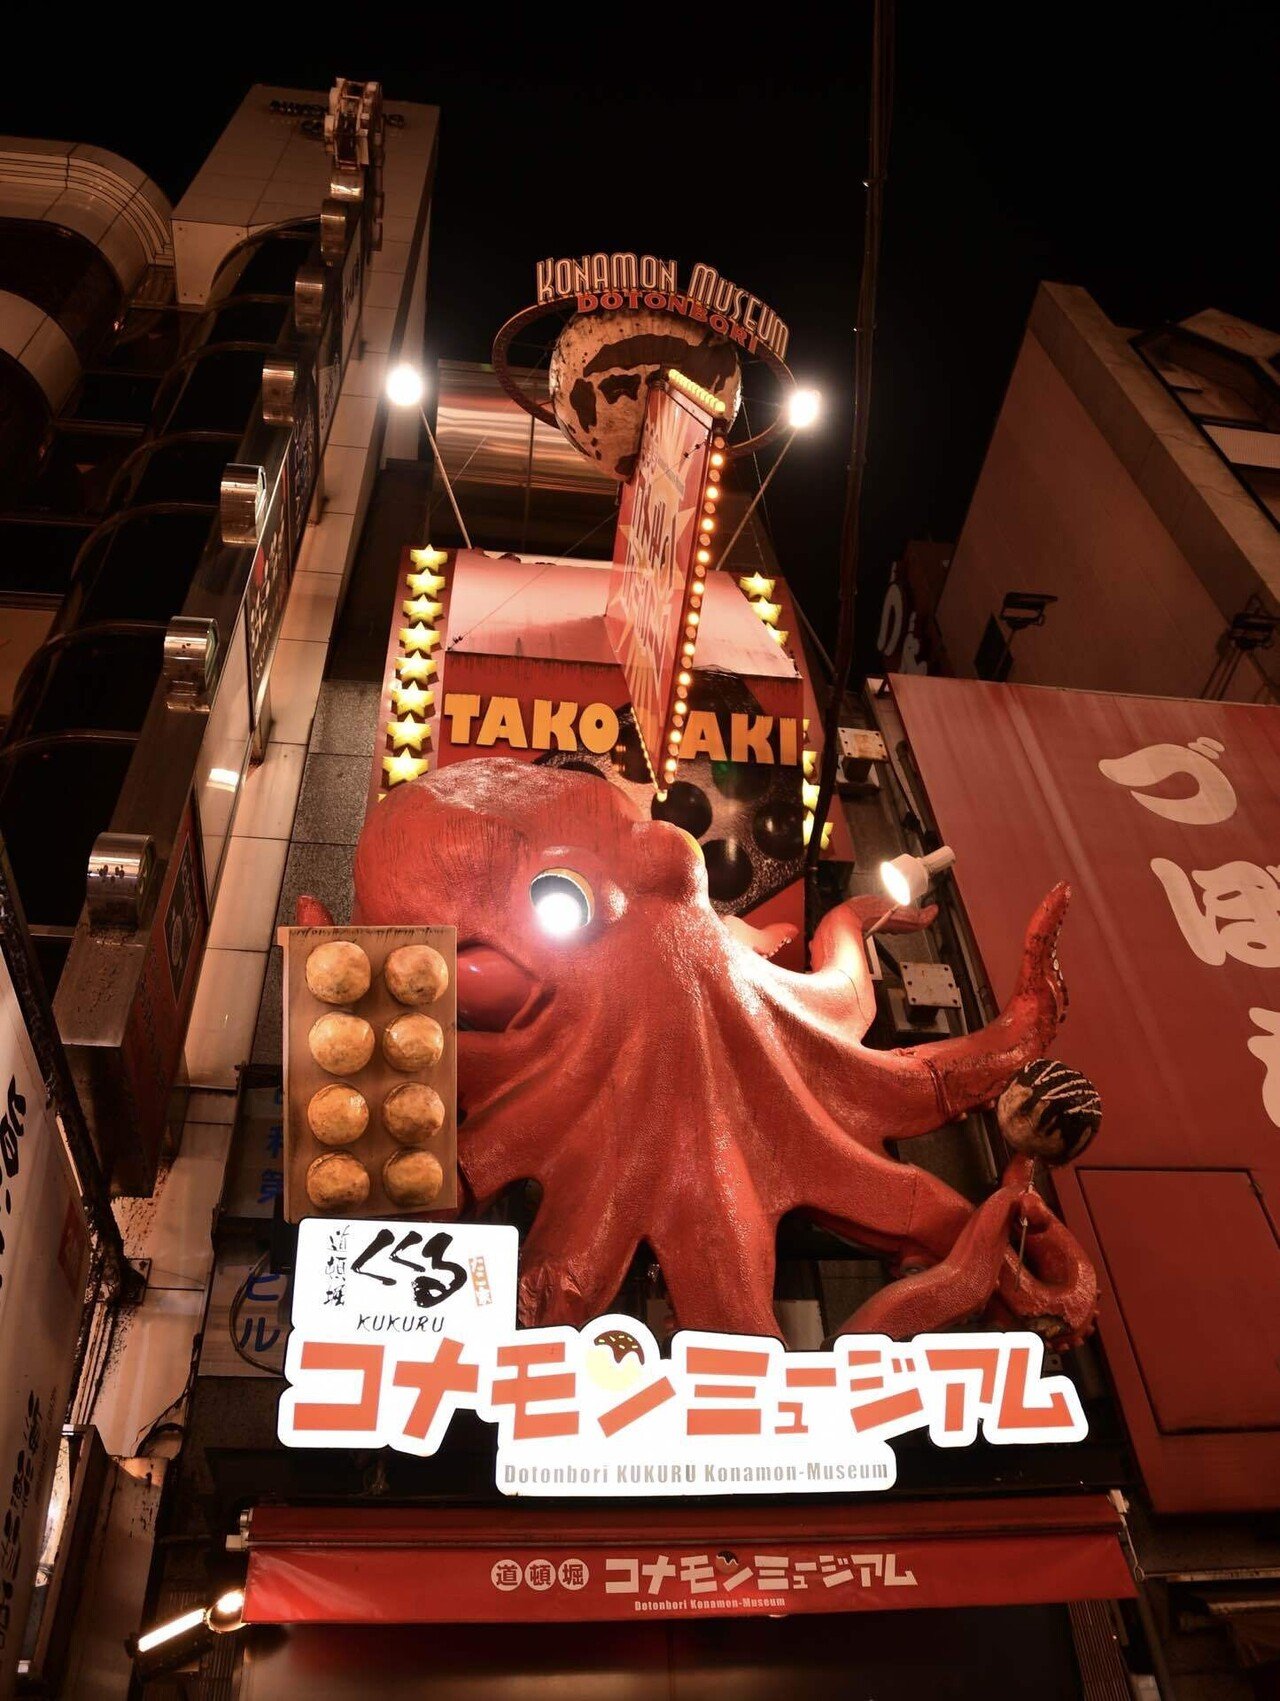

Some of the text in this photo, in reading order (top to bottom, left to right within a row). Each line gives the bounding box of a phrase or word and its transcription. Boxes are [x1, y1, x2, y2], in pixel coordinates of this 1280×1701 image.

[536, 252, 790, 360] KONAMON MUSEUM
[577, 291, 757, 354] DOTONBORI
[444, 693, 798, 766] TAKOAKI
[323, 1224, 352, 1307] 道頓堀
[350, 1228, 468, 1308] くくる
[356, 1313, 446, 1333] KUKURU
[293, 1337, 1076, 1440] コナモンミュージアム
[504, 1461, 889, 1485] Dotonbori KUKURU Konamon-Museum
[492, 1553, 918, 1595] 道頓堀 コナモンミュージアム
[634, 1597, 786, 1611] Dotonbori Konamon-Museum
